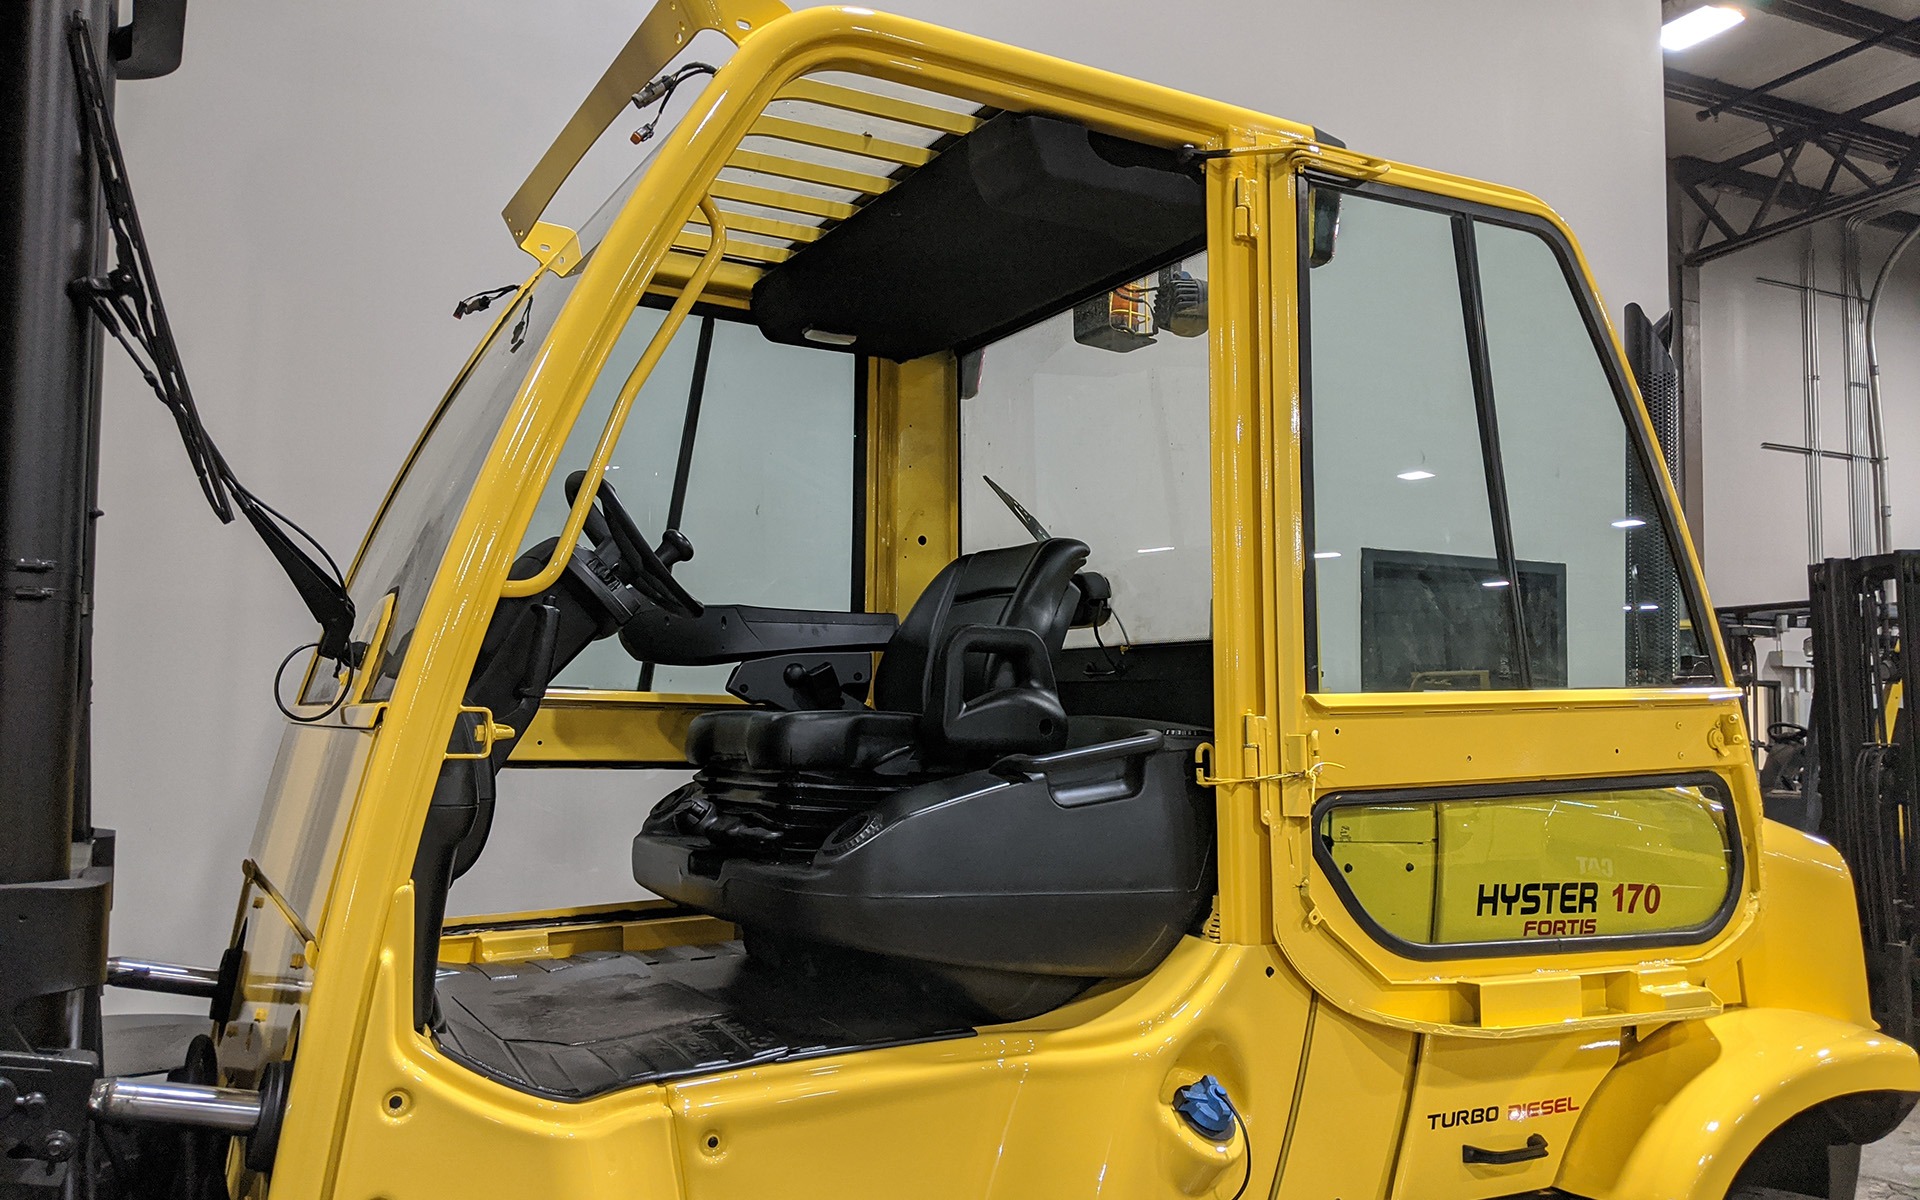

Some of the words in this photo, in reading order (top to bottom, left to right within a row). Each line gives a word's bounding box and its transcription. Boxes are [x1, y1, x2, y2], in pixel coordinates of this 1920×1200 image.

[1477, 882, 1598, 916] HYSTER
[1612, 883, 1660, 914] 170
[1523, 919, 1596, 936] FORTIS
[1427, 1106, 1499, 1130] TURBO
[1508, 1097, 1579, 1121] DIESEL
